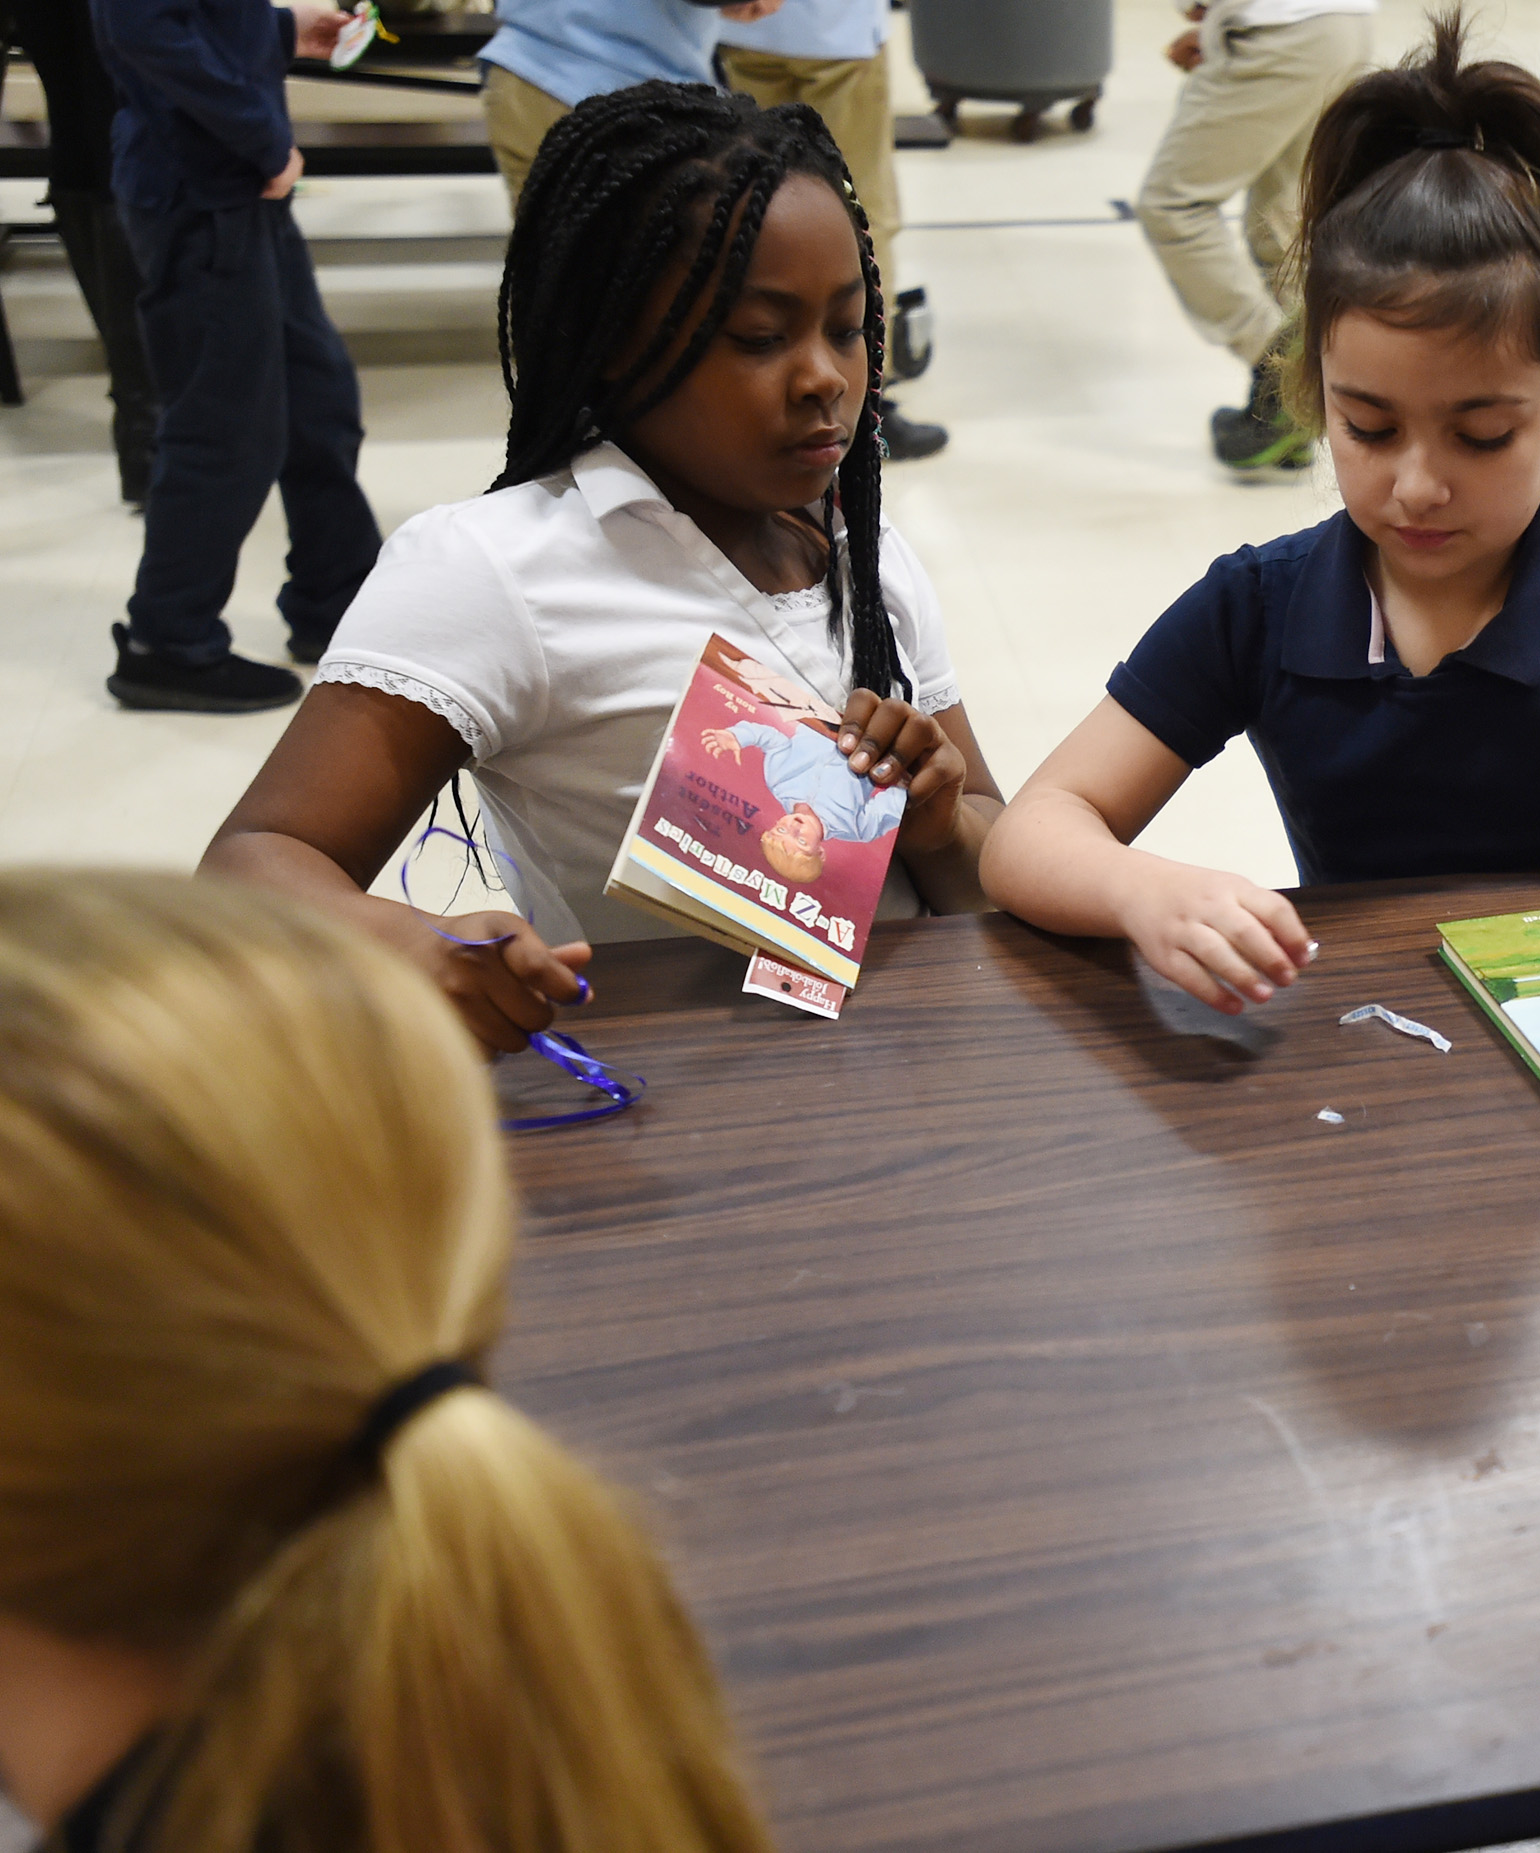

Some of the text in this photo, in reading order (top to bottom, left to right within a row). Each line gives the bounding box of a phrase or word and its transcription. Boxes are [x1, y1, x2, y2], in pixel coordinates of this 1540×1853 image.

[712, 683, 735, 701] Roy
[678, 785, 754, 835] Absent
[685, 770, 760, 819] Author
[798, 987, 837, 1012] Happy
